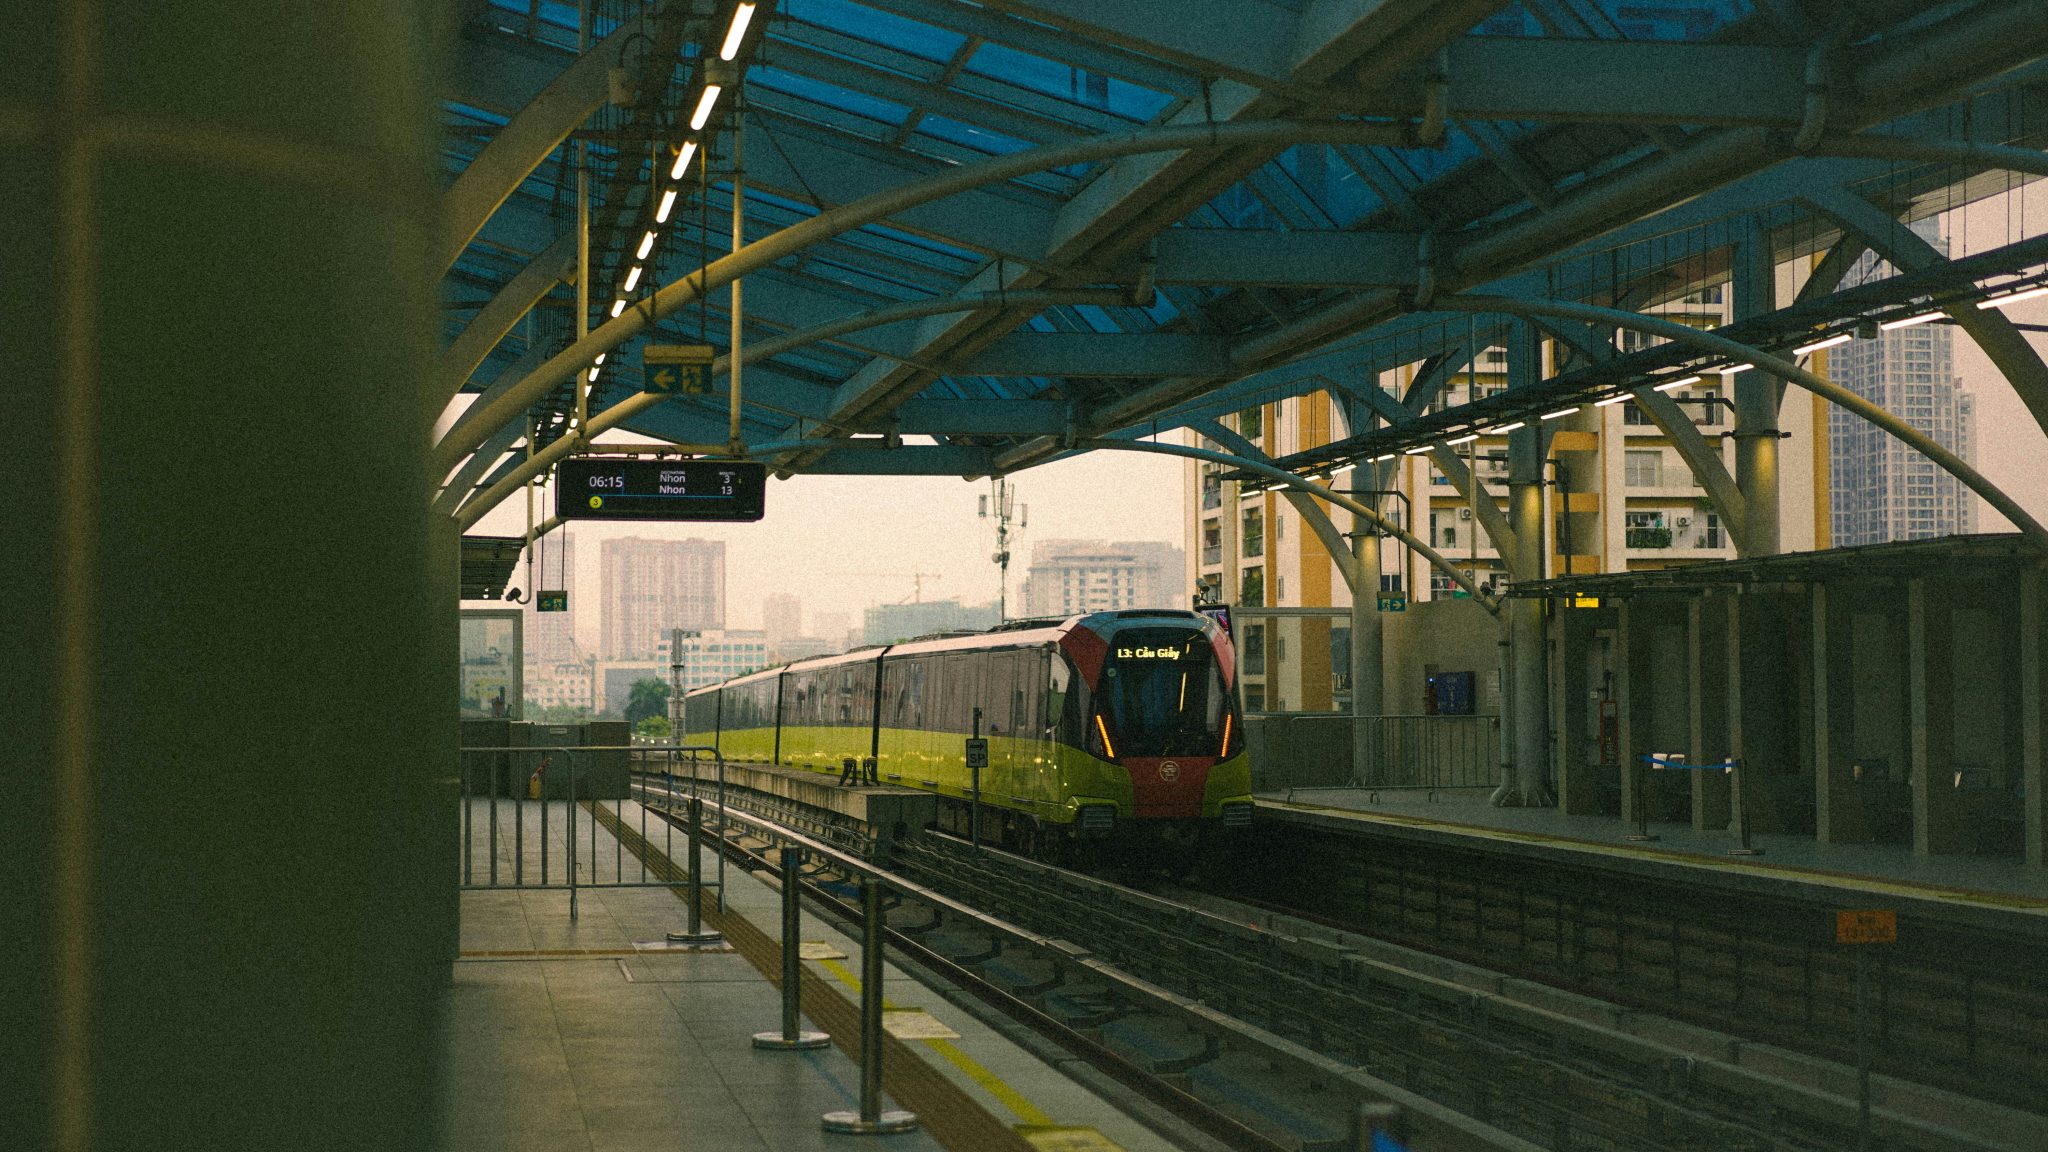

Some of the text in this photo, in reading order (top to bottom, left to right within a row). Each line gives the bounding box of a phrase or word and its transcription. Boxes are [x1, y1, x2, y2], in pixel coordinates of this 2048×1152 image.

[589, 476, 623, 488] 06:15
[660, 474, 686, 483] Nhon
[724, 475, 730, 483] 3
[659, 485, 685, 494] Nhon
[721, 486, 733, 495] 13
[1118, 649, 1133, 658] L3:
[970, 753, 986, 764] SP
